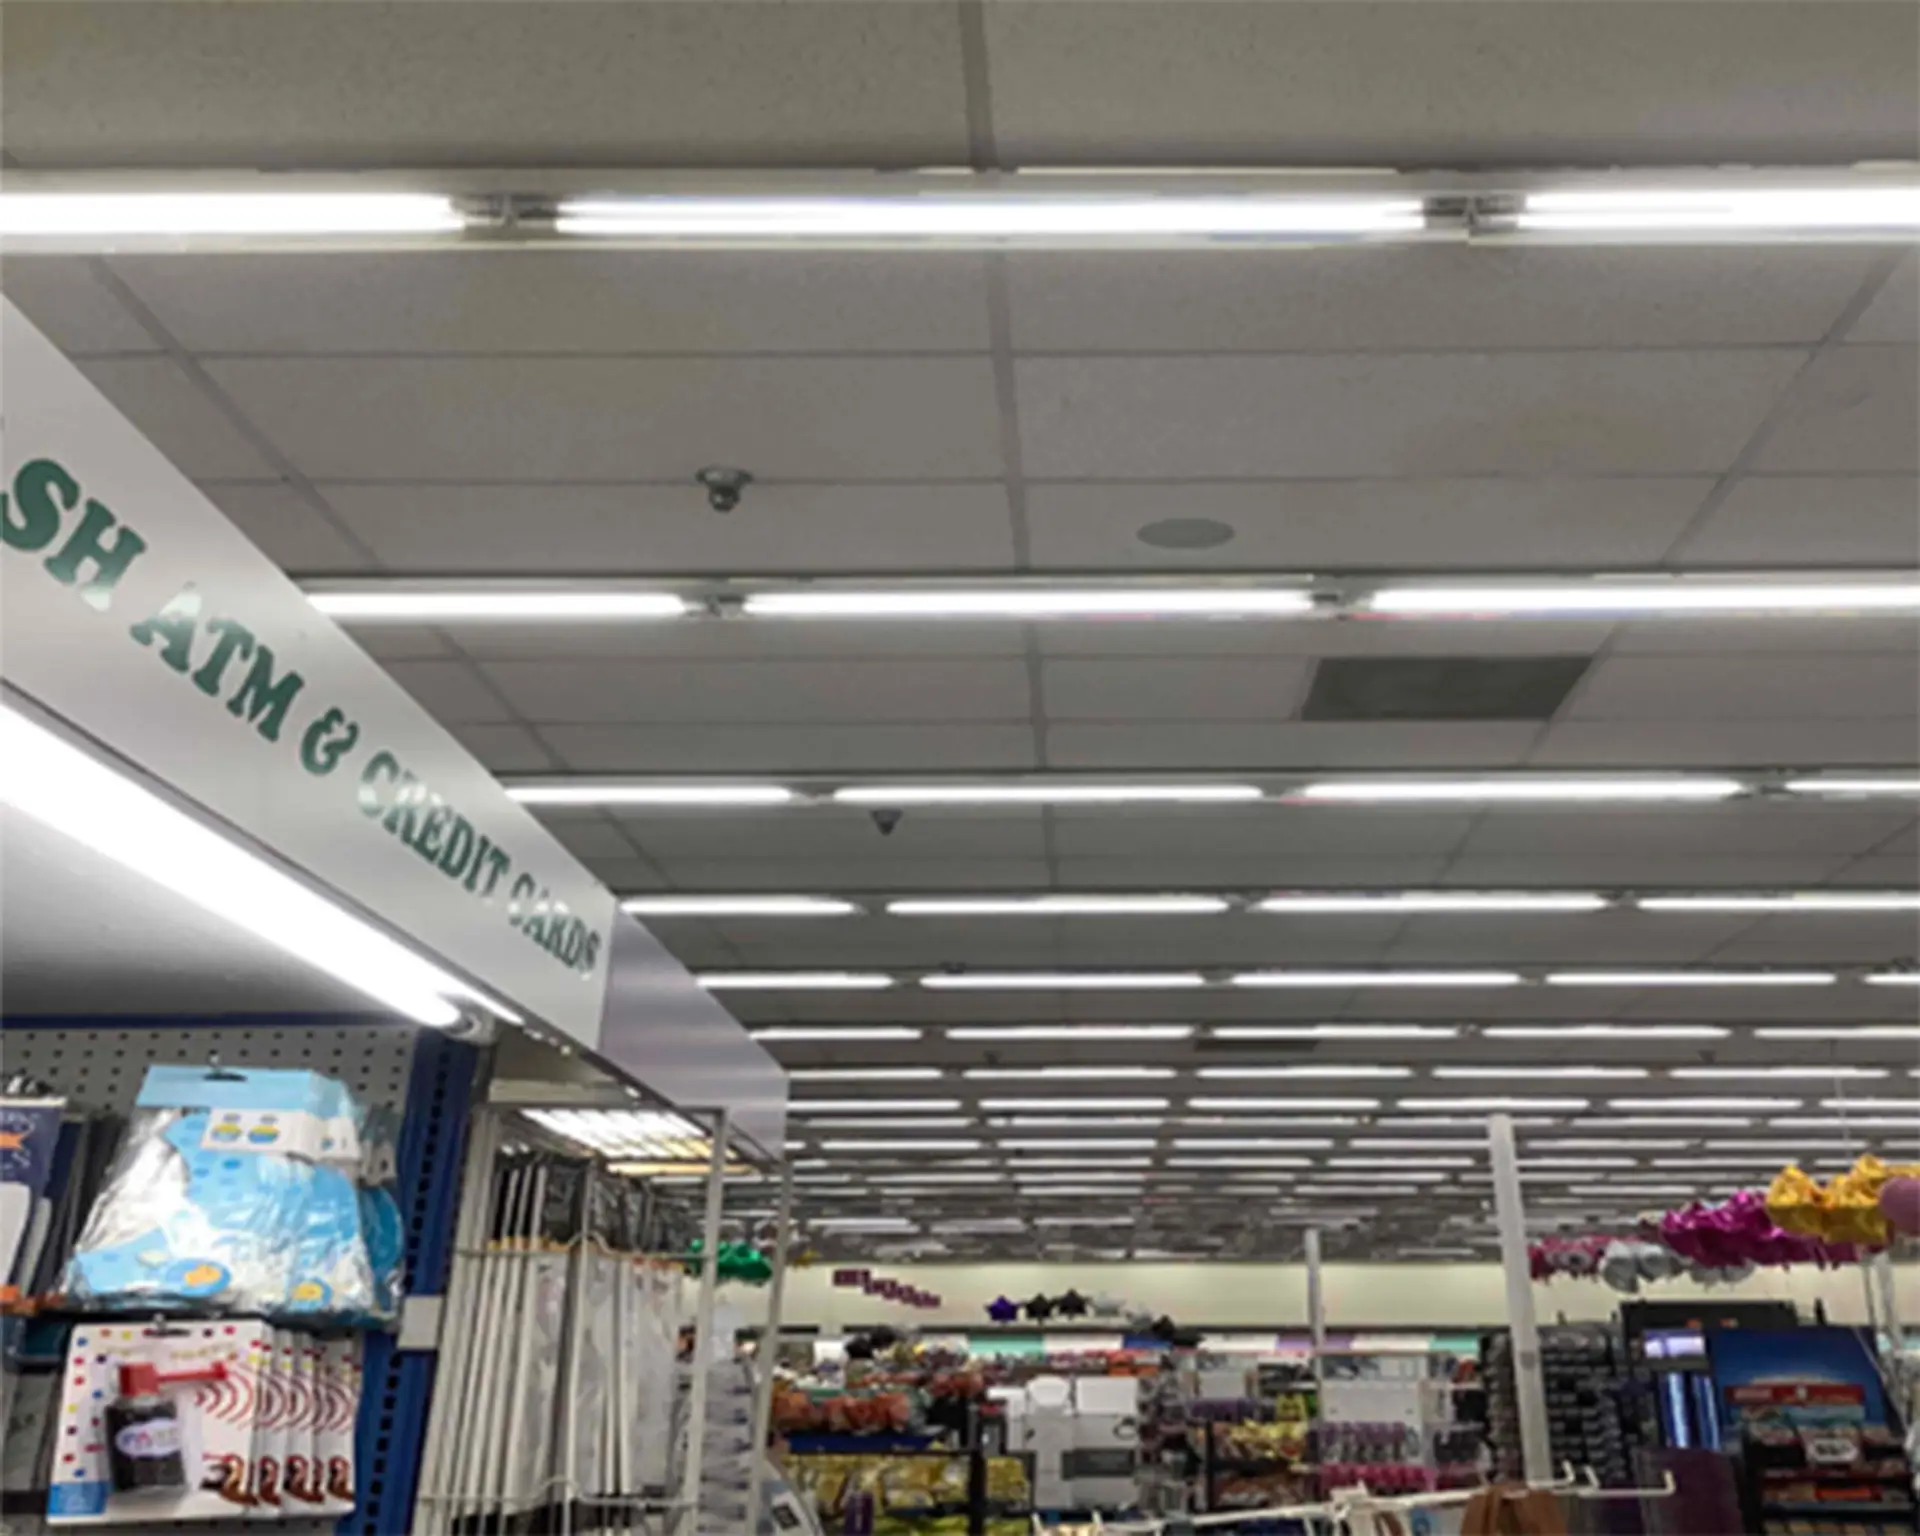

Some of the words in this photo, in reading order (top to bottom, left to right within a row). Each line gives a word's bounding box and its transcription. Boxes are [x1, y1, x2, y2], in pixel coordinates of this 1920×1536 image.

[130, 581, 304, 742] ATM
[301, 707, 359, 775] &
[357, 751, 511, 906] CREDIT
[508, 872, 601, 980] CARDS
